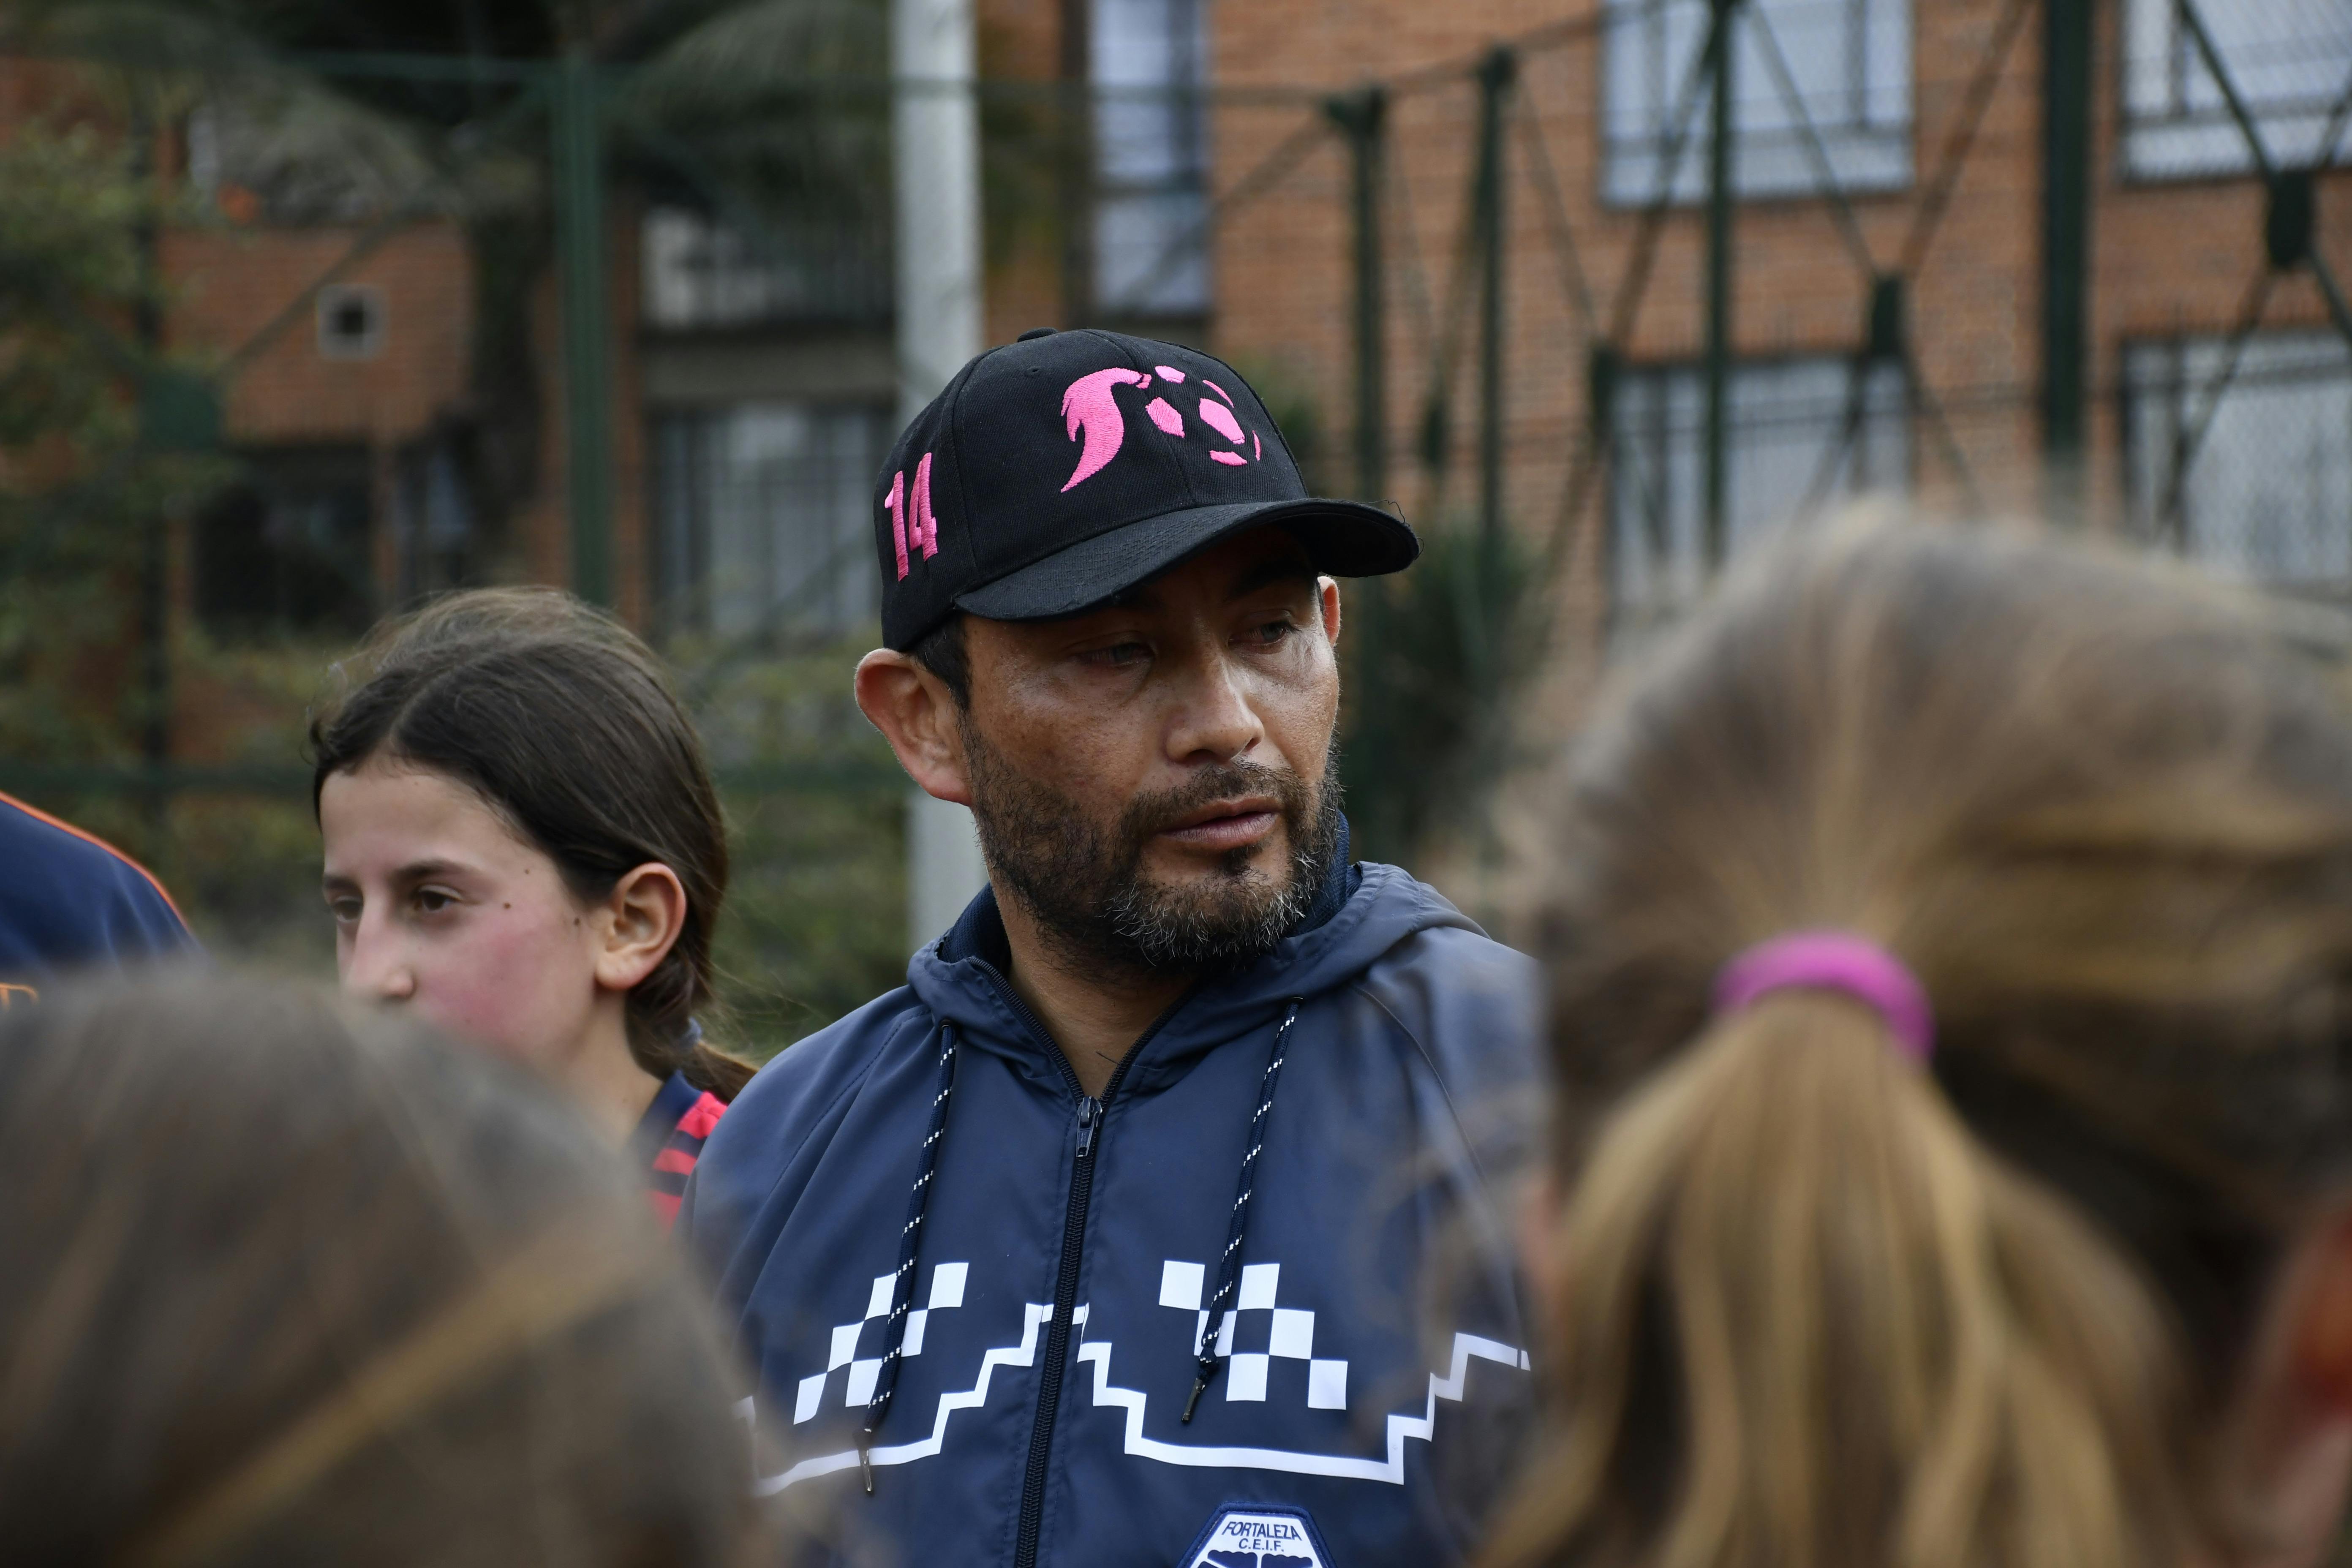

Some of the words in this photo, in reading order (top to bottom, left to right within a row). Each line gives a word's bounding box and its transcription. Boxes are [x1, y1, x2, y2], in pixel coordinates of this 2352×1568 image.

[884, 452, 938, 582] 14
[1222, 1522, 1302, 1541] FORTALEZA
[1239, 1538, 1284, 1552] C.E.I.F.
